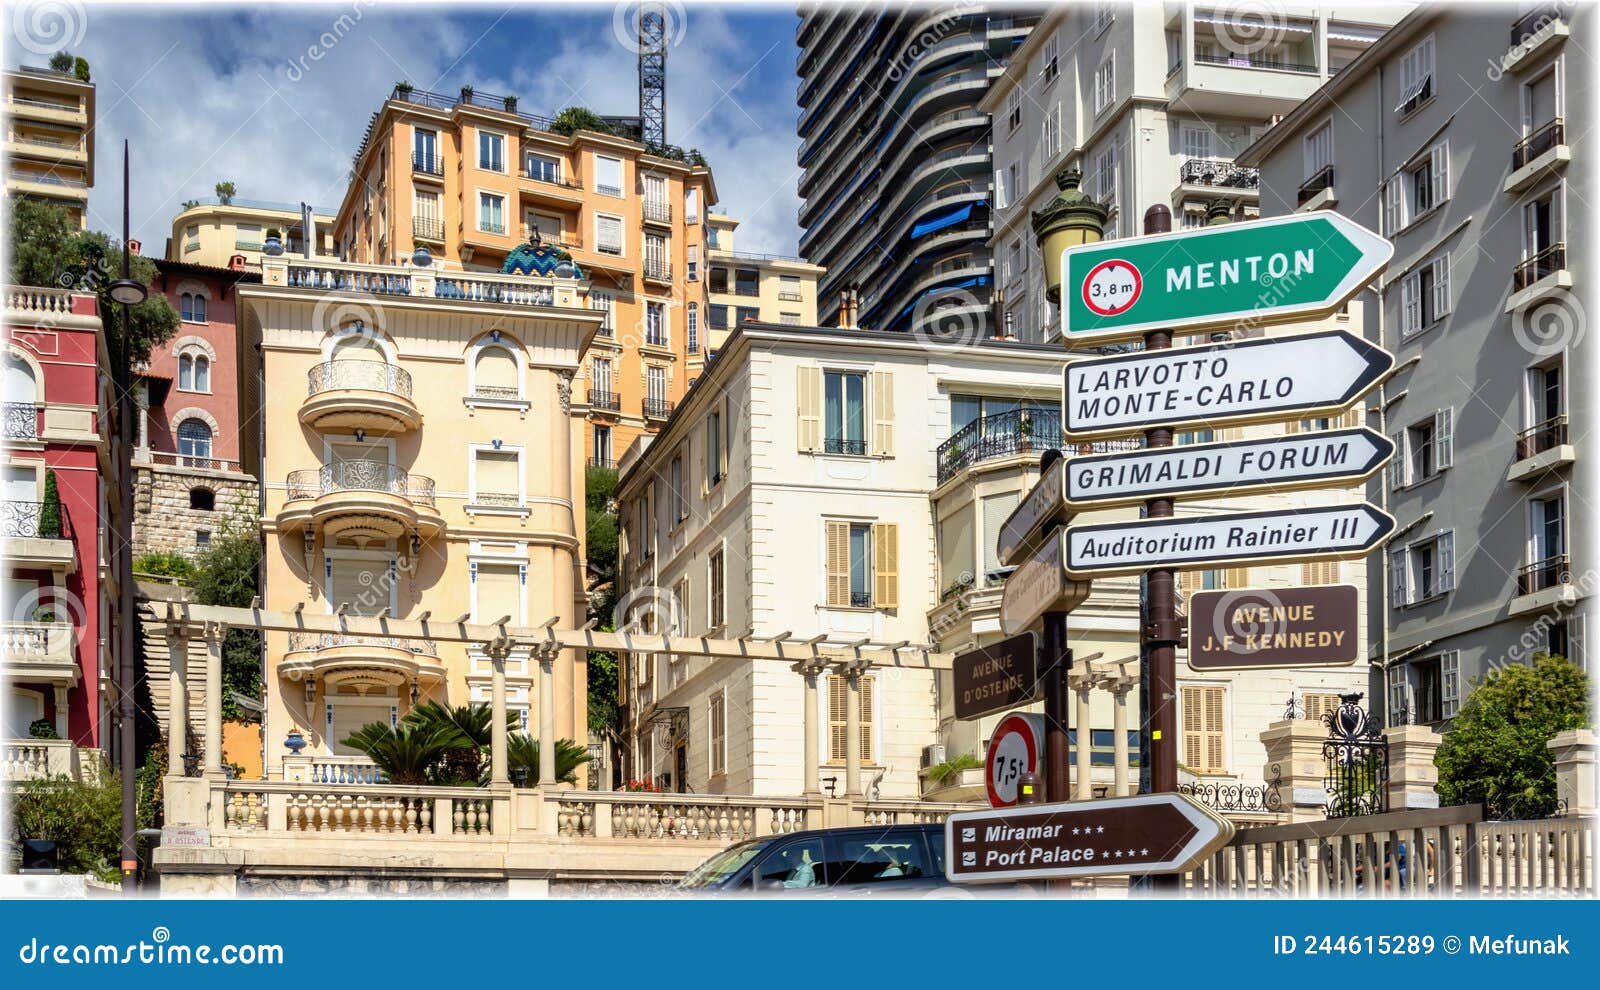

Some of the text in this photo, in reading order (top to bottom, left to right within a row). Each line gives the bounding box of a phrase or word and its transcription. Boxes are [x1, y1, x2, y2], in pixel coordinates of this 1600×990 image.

[1166, 249, 1314, 293] MENTON
[1092, 282, 1117, 298] 3,8
[1078, 357, 1228, 394] LARVOTTO
[1078, 376, 1293, 420] MONTE-CARLO
[1078, 443, 1349, 489] GRIMALDI FORUM
[1080, 517, 1358, 559] Auditorium Rainier III
[1232, 605, 1315, 624] AVENUE
[1202, 631, 1345, 652] J.F KENNEDY
[972, 654, 1014, 680] AVENUE
[964, 673, 1024, 704] D'OSTENDE
[985, 824, 1063, 842] Miramar
[985, 847, 1094, 866] Port Palace
